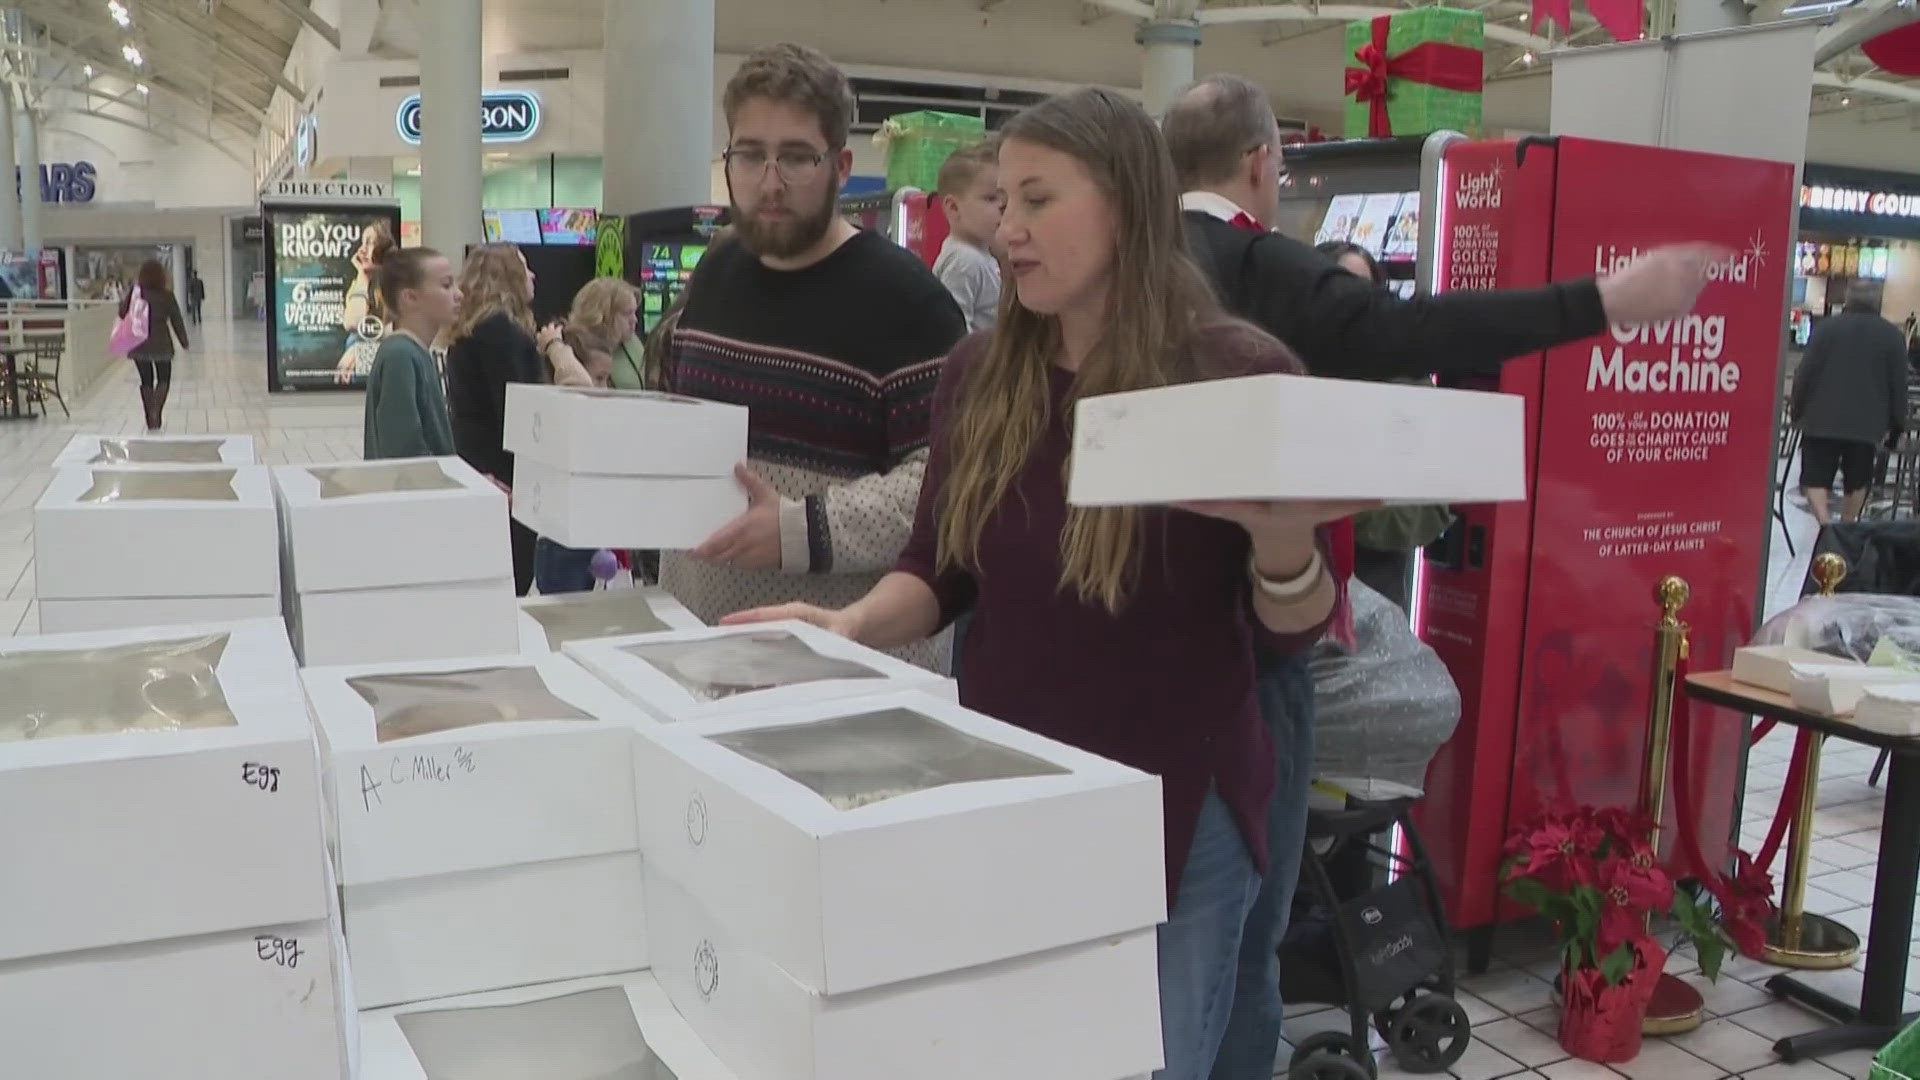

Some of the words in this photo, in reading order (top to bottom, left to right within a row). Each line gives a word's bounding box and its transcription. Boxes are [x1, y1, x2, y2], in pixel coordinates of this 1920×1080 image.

[278, 182, 385, 196] DIRECTORY
[1460, 172, 1495, 194] Light
[1455, 189, 1501, 209] World
[282, 223, 316, 240] DID
[320, 223, 360, 241] YOU
[1453, 224, 1480, 239] 100%
[282, 240, 352, 257] KNOW?
[1452, 239, 1499, 249] DONATION
[1452, 249, 1487, 263] GOES
[1451, 263, 1497, 276] CHARITY
[1700, 254, 1748, 282] orld
[1450, 277, 1496, 290] CAUSE
[285, 312, 344, 325] VICTIMS
[1586, 345, 1740, 392] Machine
[1592, 412, 1625, 430] 100%
[1650, 411, 1730, 429] DONATION
[1590, 432, 1625, 447] GOES
[1637, 431, 1689, 446] CHARITY
[1691, 430, 1728, 445] CAUSE
[1606, 448, 1623, 463] OF
[1627, 447, 1661, 462] YOUR
[1664, 446, 1709, 461] CHOICE
[1583, 528, 1601, 541] THE
[1604, 525, 1644, 540] CHURCH
[1646, 523, 1660, 538] OF
[1660, 521, 1687, 538] JESUS
[1689, 520, 1721, 534] CHRIST
[1599, 544, 1613, 557] OF
[1674, 538, 1704, 552] SAINTS
[361, 764, 382, 812] A
[412, 755, 451, 782] Miller
[255, 935, 304, 968] Egg
